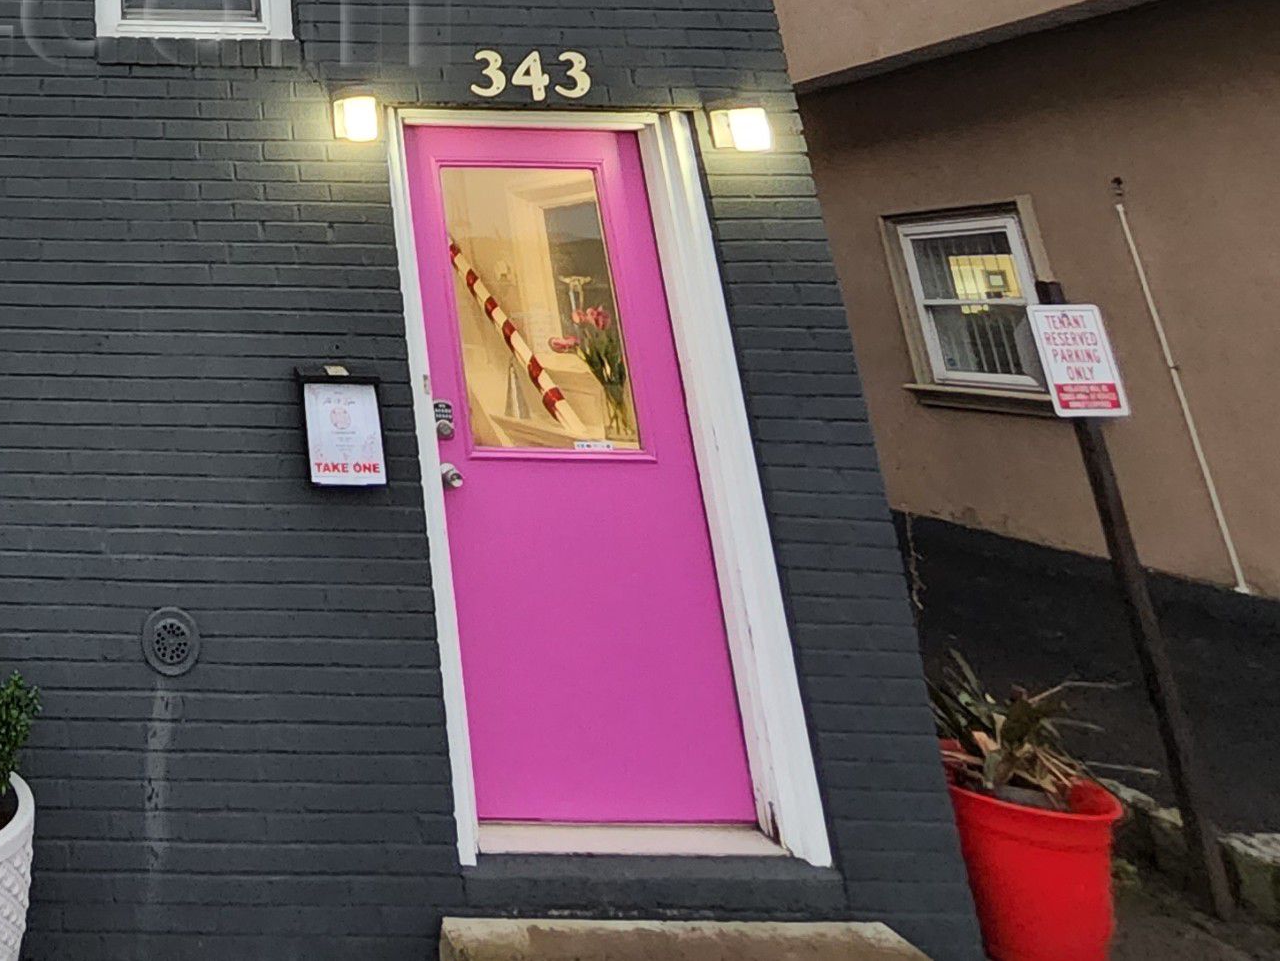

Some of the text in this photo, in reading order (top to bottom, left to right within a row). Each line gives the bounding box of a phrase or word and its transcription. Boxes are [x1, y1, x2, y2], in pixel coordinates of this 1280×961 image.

[470, 49, 592, 102] 343
[1043, 313, 1087, 330] TENANT
[1043, 331, 1099, 347] RESERVED
[1051, 348, 1102, 364] PARKING
[1066, 366, 1095, 381] ONLY
[314, 461, 381, 474] TAKE ONE
